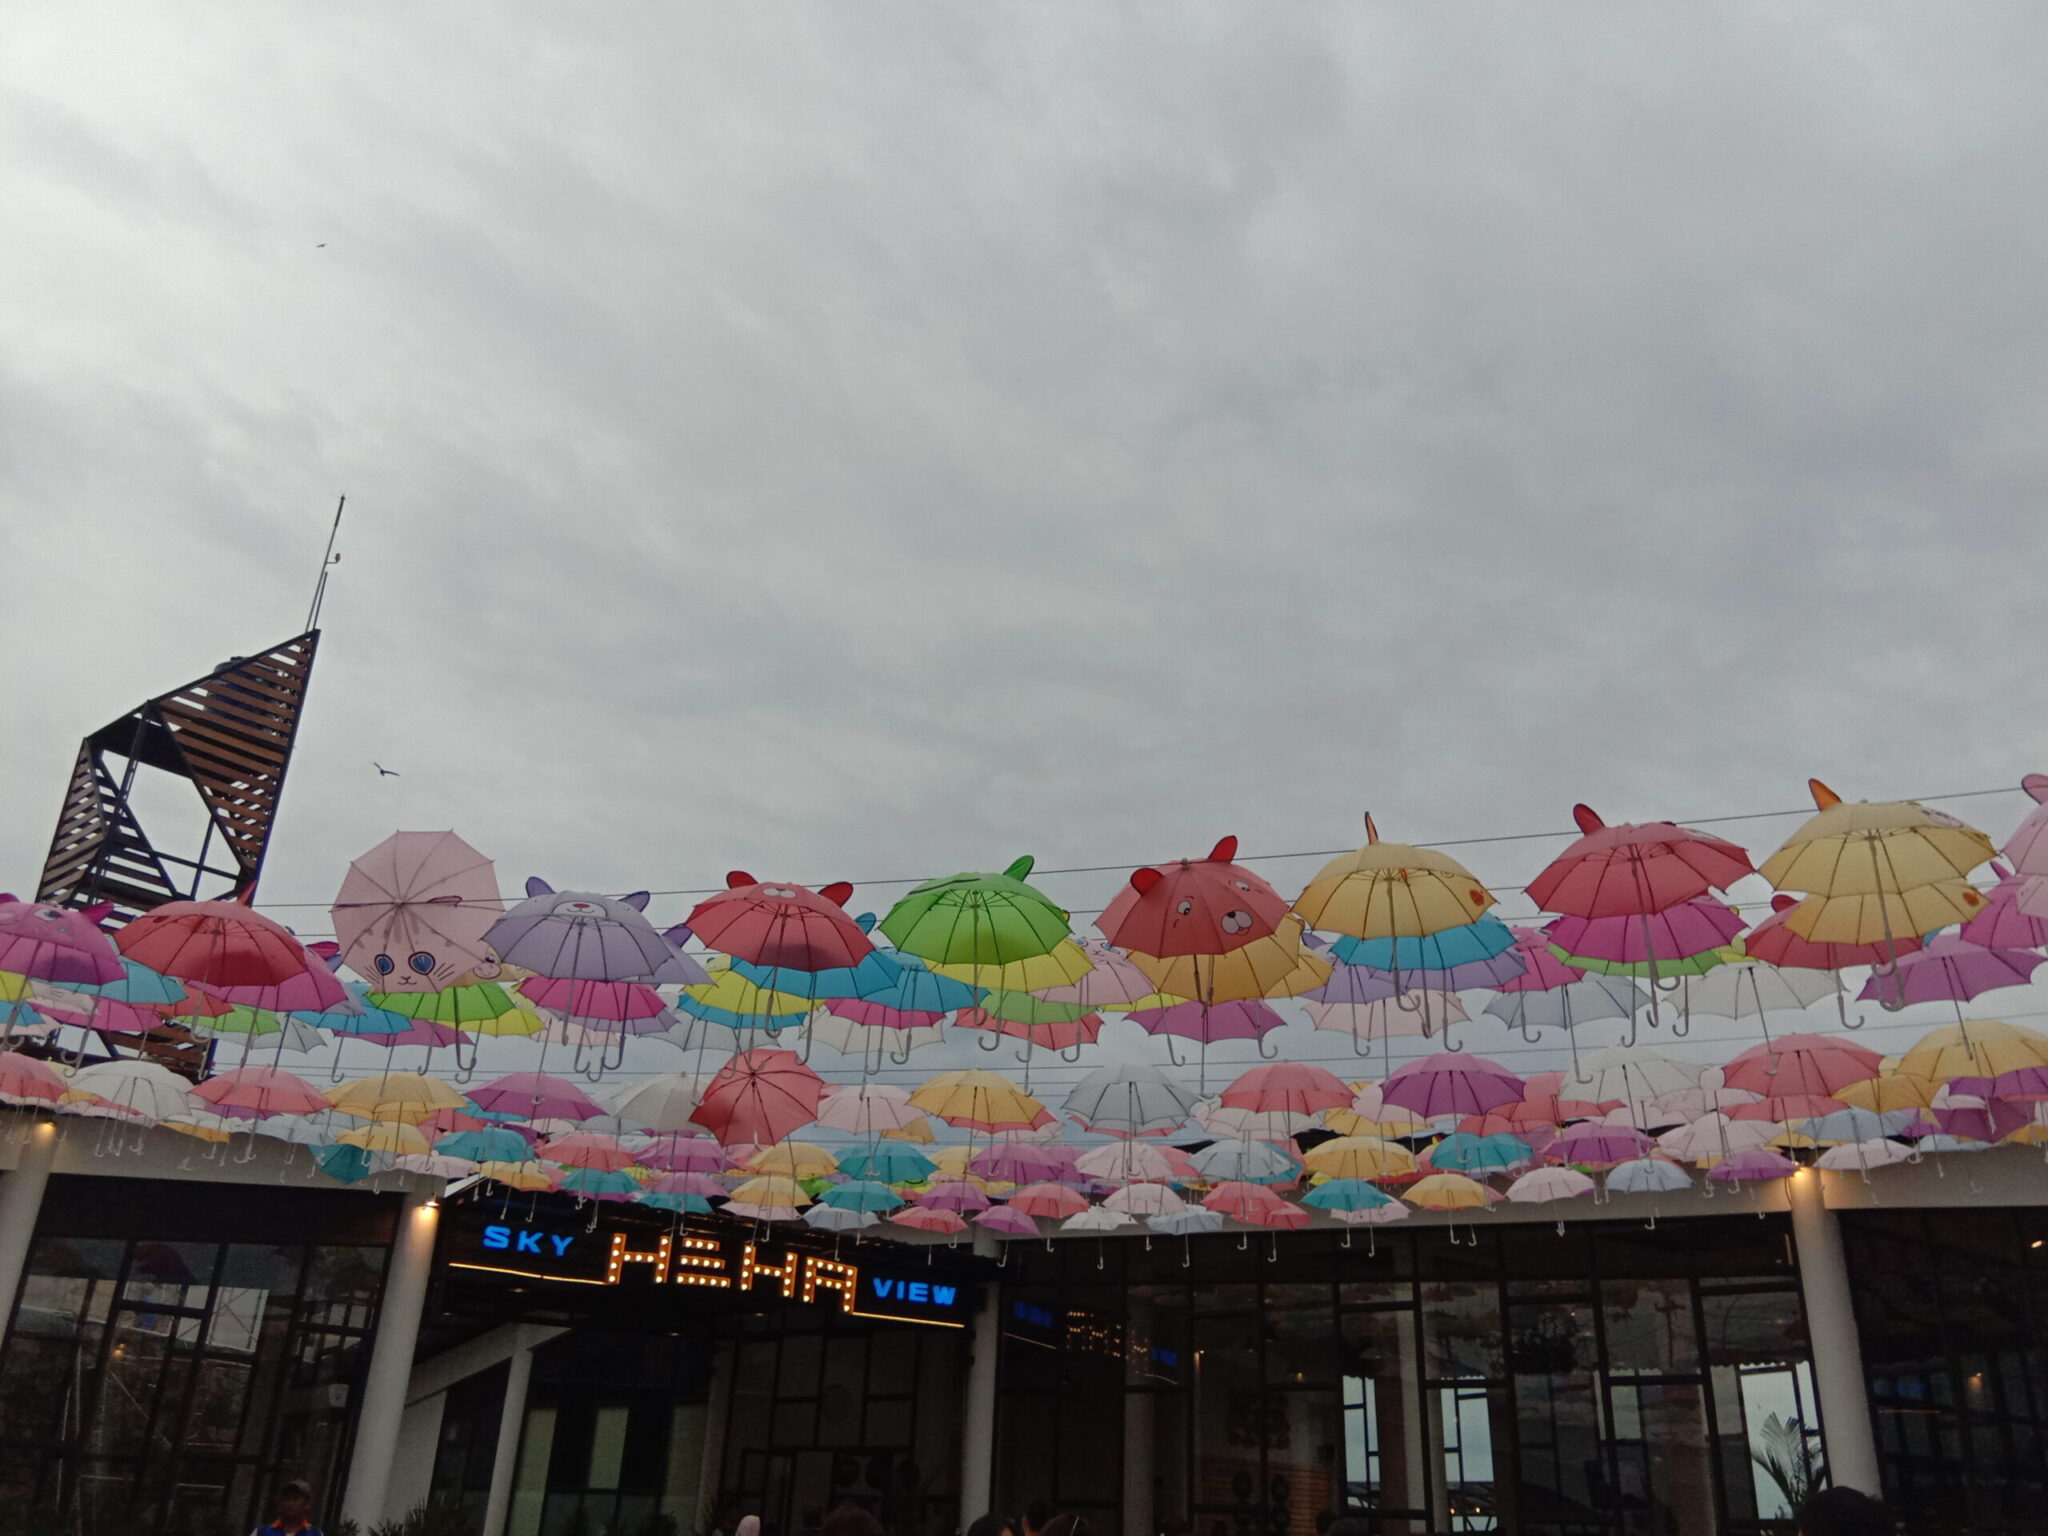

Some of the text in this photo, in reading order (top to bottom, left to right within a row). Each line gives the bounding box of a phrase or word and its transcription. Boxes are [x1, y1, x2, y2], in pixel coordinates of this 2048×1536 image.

[482, 1224, 957, 1314] SKY HEHA VIEW
